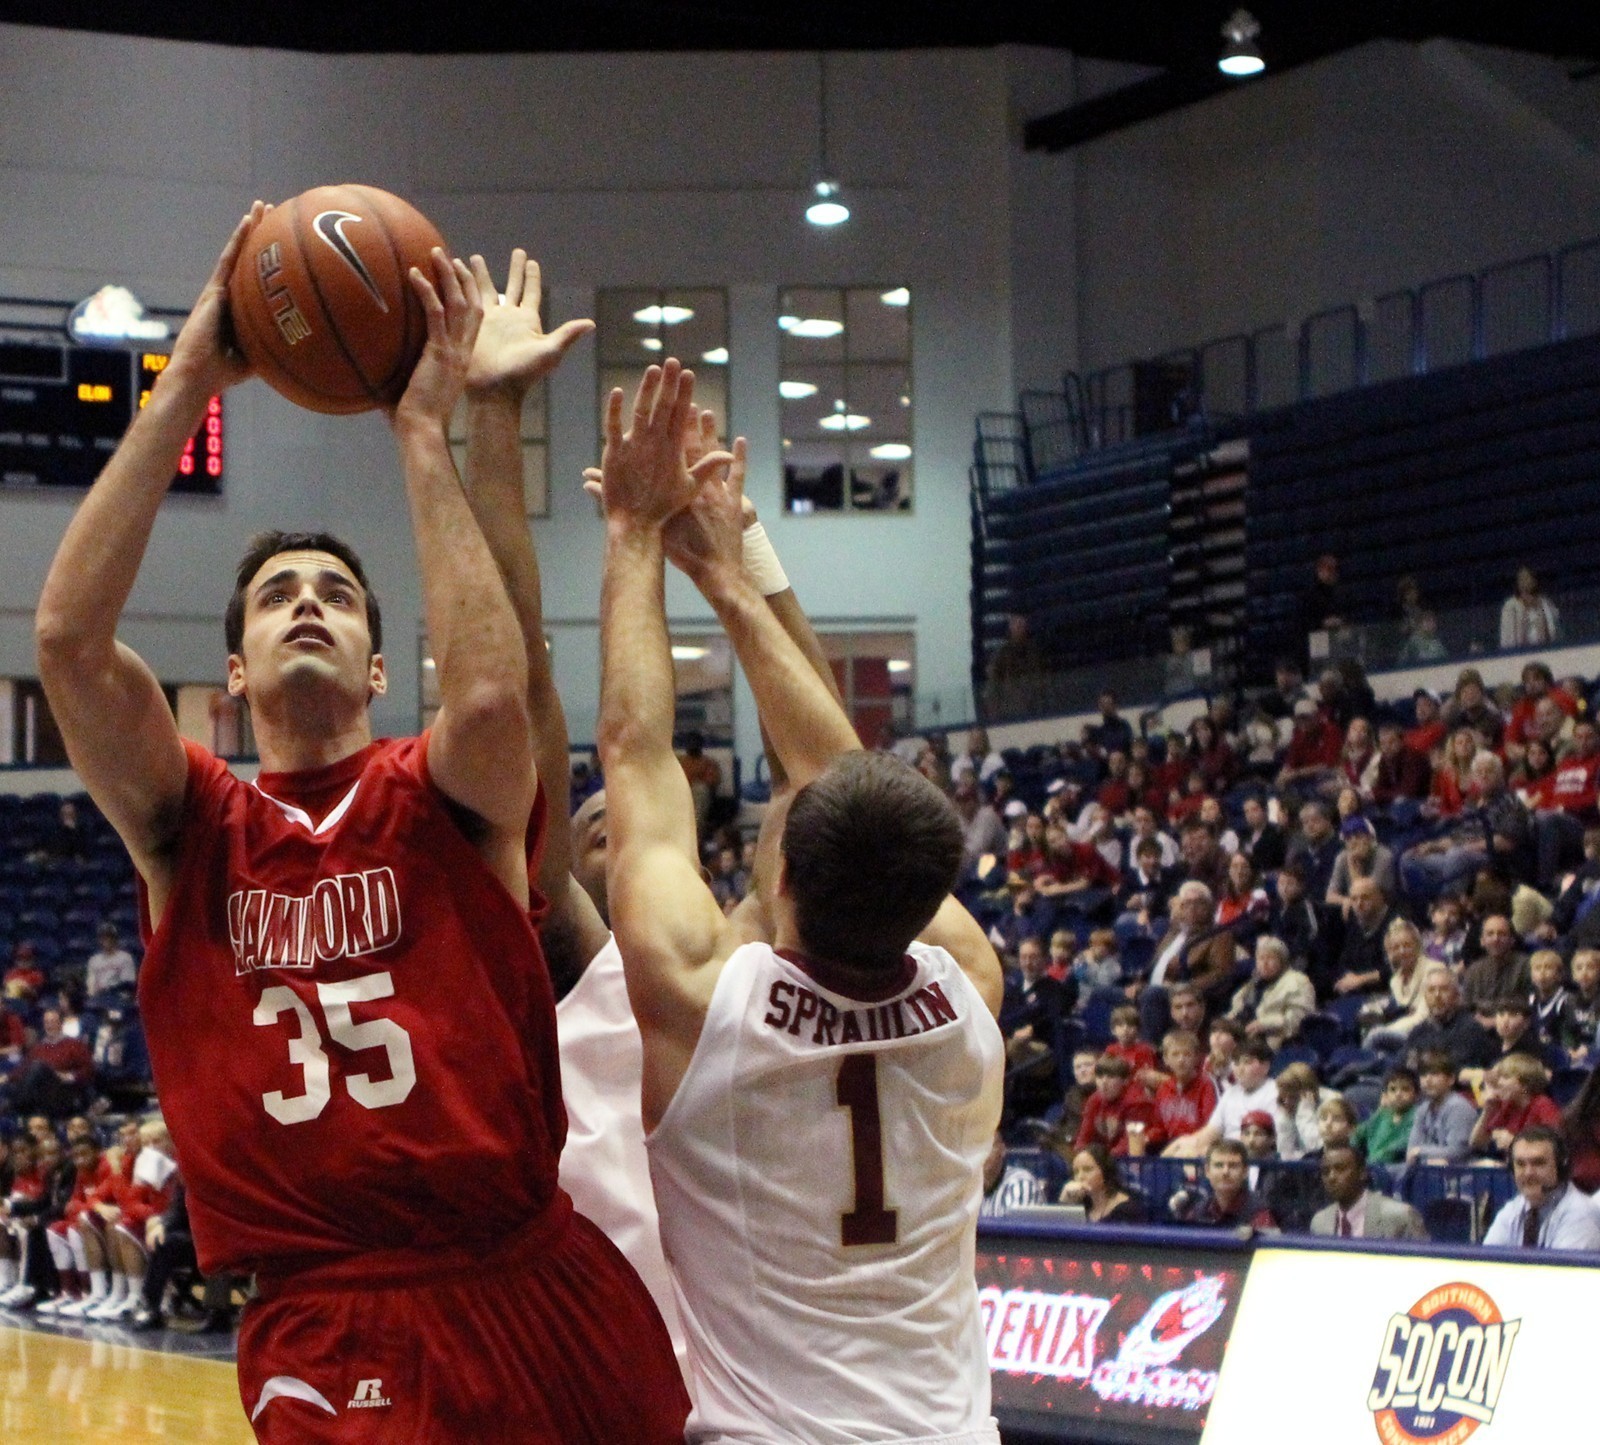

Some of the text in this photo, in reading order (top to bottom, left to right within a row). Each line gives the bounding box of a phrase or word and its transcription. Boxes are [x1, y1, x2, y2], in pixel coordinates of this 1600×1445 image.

[257, 242, 312, 345] ELITE
[252, 971, 417, 1126] 35
[836, 1053, 899, 1247] 1
[1421, 1287, 1493, 1321] SOUTHERN
[347, 1399, 392, 1409] RUSSELL
[353, 1378, 382, 1400] R
[1367, 1312, 1522, 1418] SOCON
